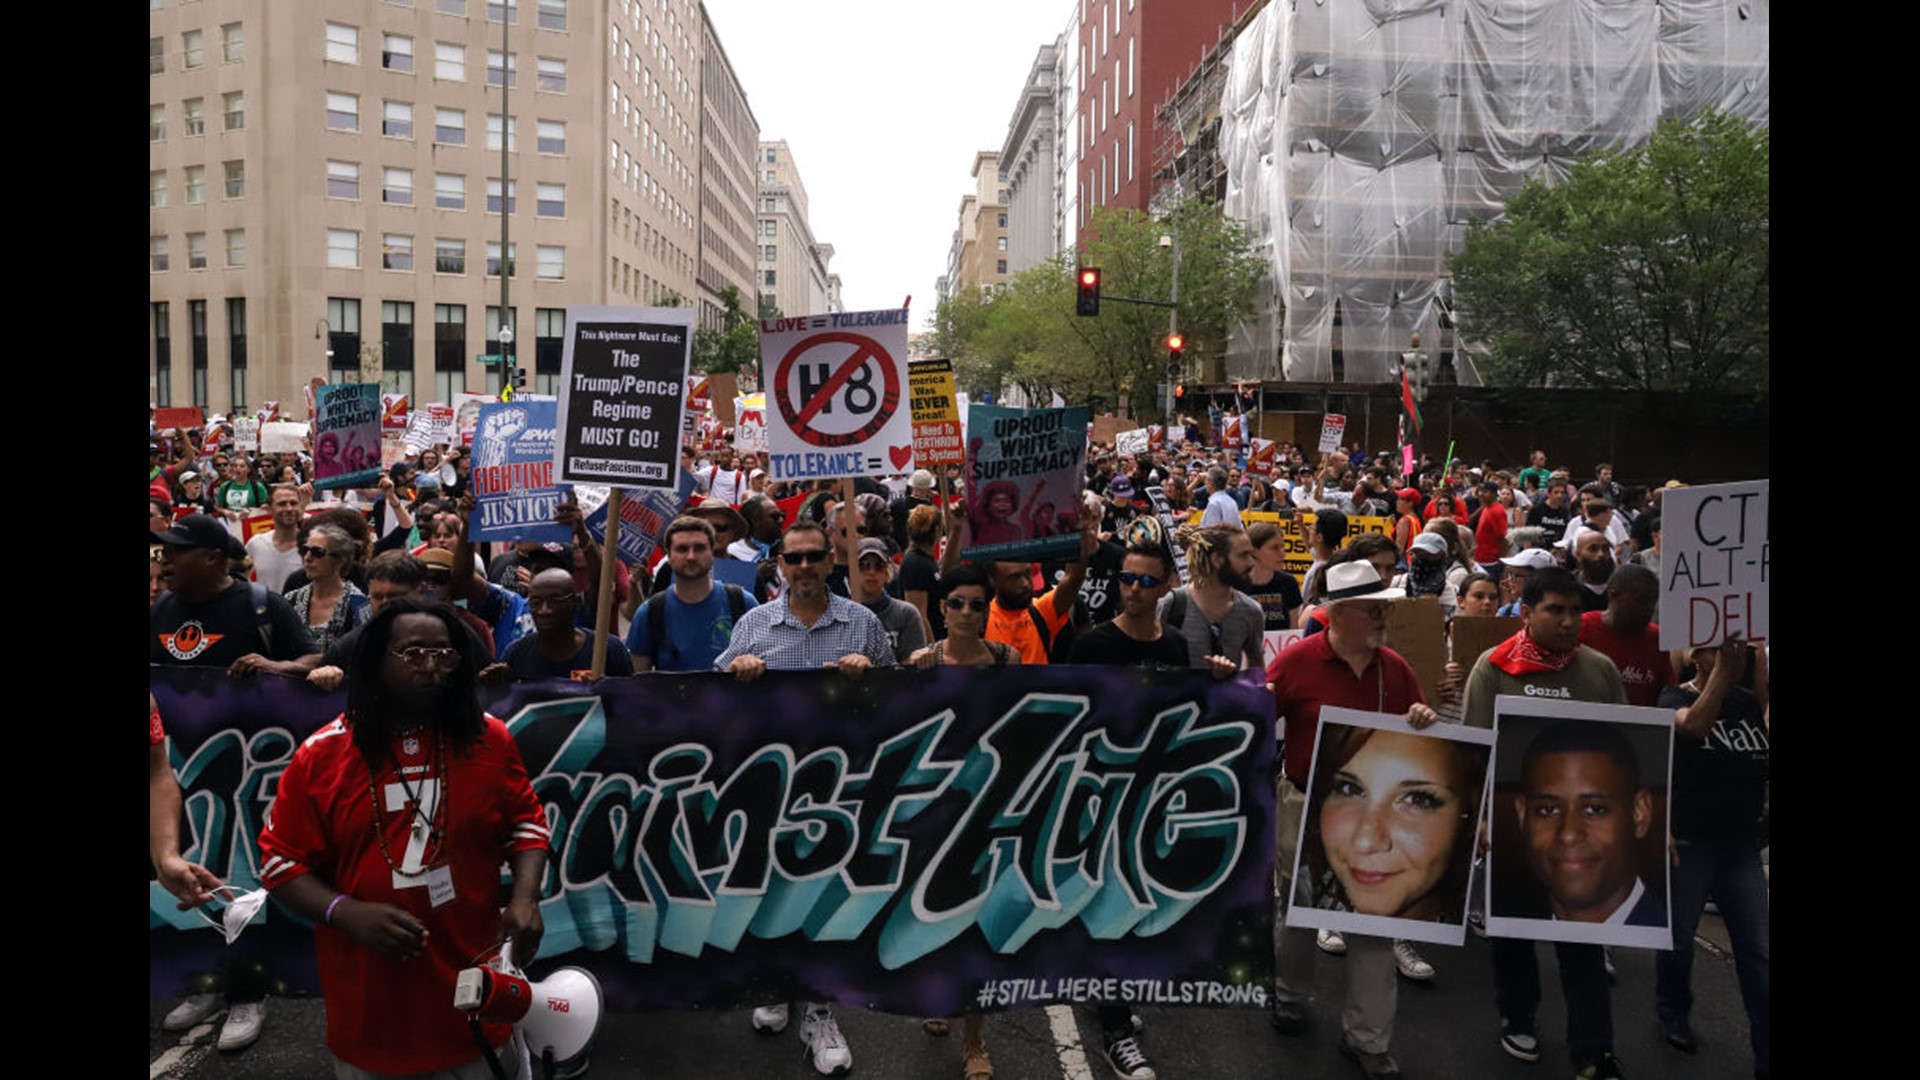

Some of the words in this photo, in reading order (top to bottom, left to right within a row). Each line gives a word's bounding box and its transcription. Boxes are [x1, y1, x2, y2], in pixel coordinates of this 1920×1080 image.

[761, 317, 807, 334] LOVE
[831, 309, 909, 328] TOLERANCE
[581, 330, 597, 340] This
[598, 330, 637, 343] Nightmare
[639, 331, 659, 342] Must
[662, 333, 681, 344] End:
[612, 350, 640, 368] The
[575, 373, 679, 397] Trump/Pence
[909, 375, 946, 385] merica
[323, 384, 366, 404] UPROOT
[914, 387, 937, 396] Was
[327, 400, 361, 418] WHITE
[593, 401, 652, 422] Regime
[912, 410, 946, 421] Great!
[317, 409, 377, 433] SUPREMACY
[944, 423, 955, 435] To
[993, 411, 1065, 439] UPROOT
[581, 427, 624, 447] MUST
[629, 428, 660, 448] GO!
[912, 435, 960, 449] VERTHROW
[999, 432, 1059, 459] WHITE
[573, 459, 663, 478] RefuseFascism.org
[770, 452, 864, 478] TOLERANCE
[972, 448, 1081, 481] SUPREMACY
[473, 461, 555, 495] FIGHTING
[481, 494, 560, 527] JUSTICE
[1695, 492, 1769, 547] CT
[1688, 592, 1767, 648] DEL
[1523, 683, 1571, 698] Gaza&
[384, 778, 441, 889] 7
[880, 691, 1256, 971] Hate
